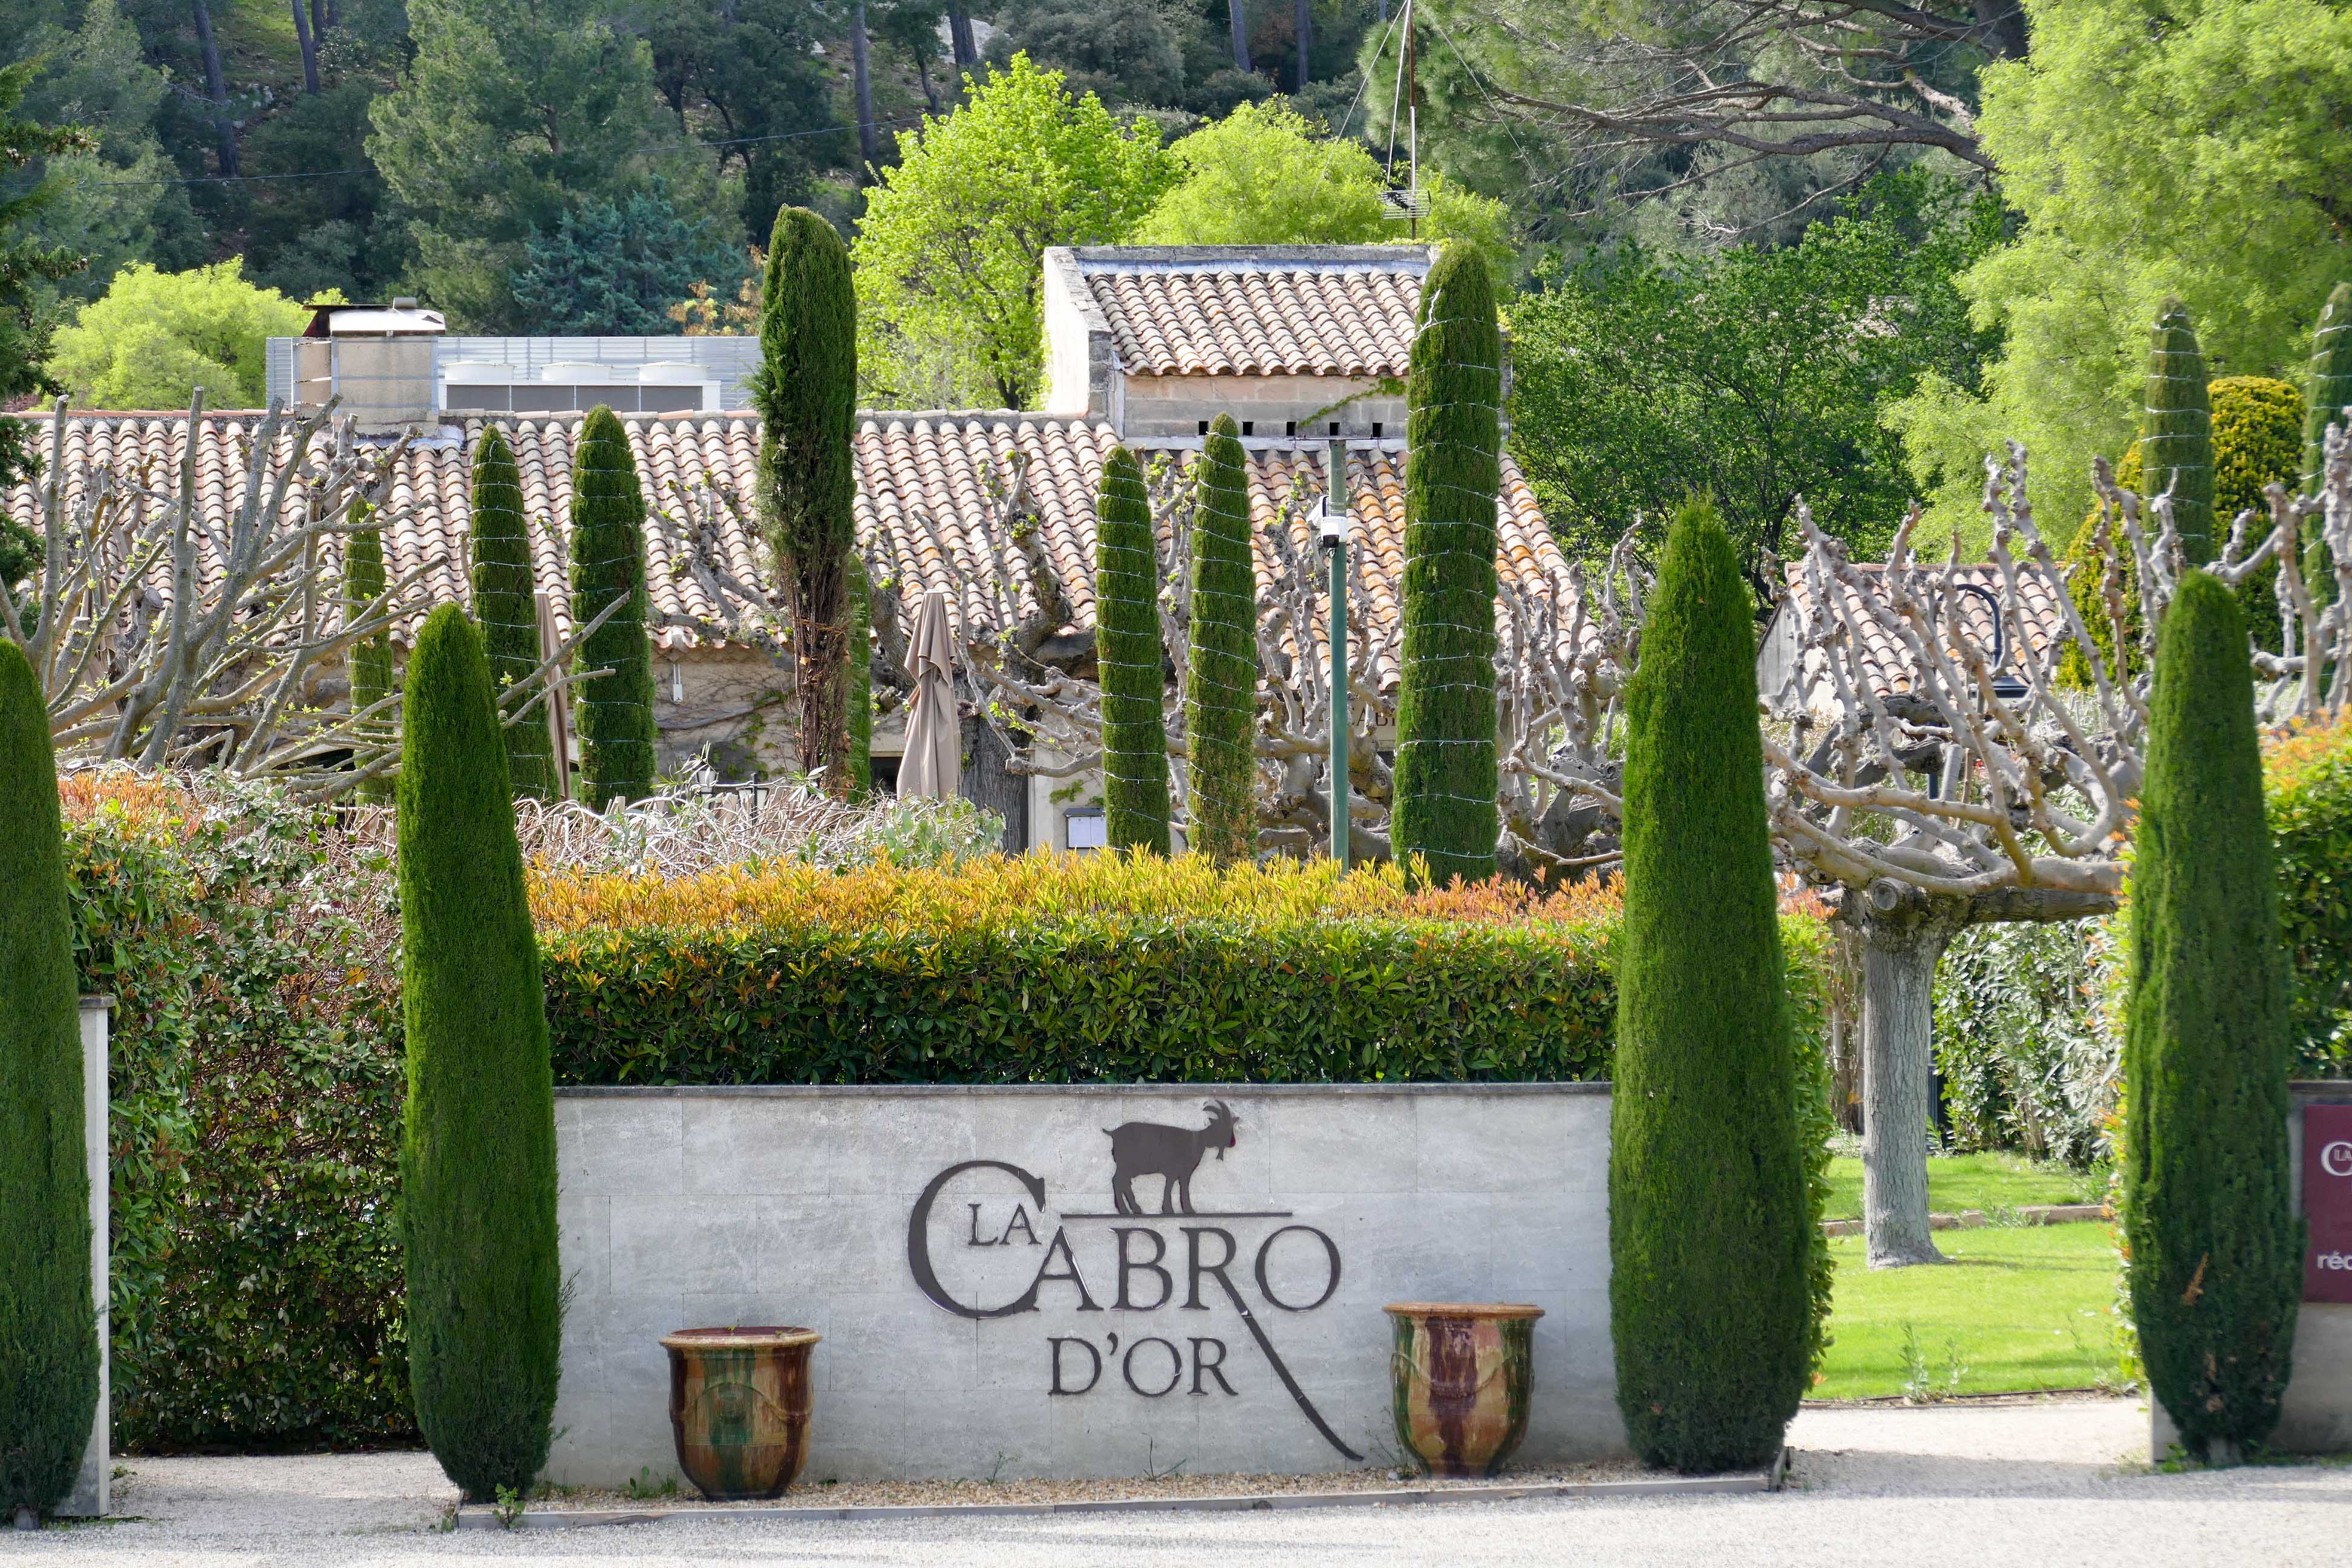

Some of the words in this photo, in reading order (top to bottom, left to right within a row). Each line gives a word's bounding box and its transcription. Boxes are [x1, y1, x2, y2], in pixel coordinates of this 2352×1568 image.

[968, 1203, 1041, 1246] LA
[908, 1160, 1363, 1461] CABRO
[1047, 1332, 1239, 1397] D'OR
